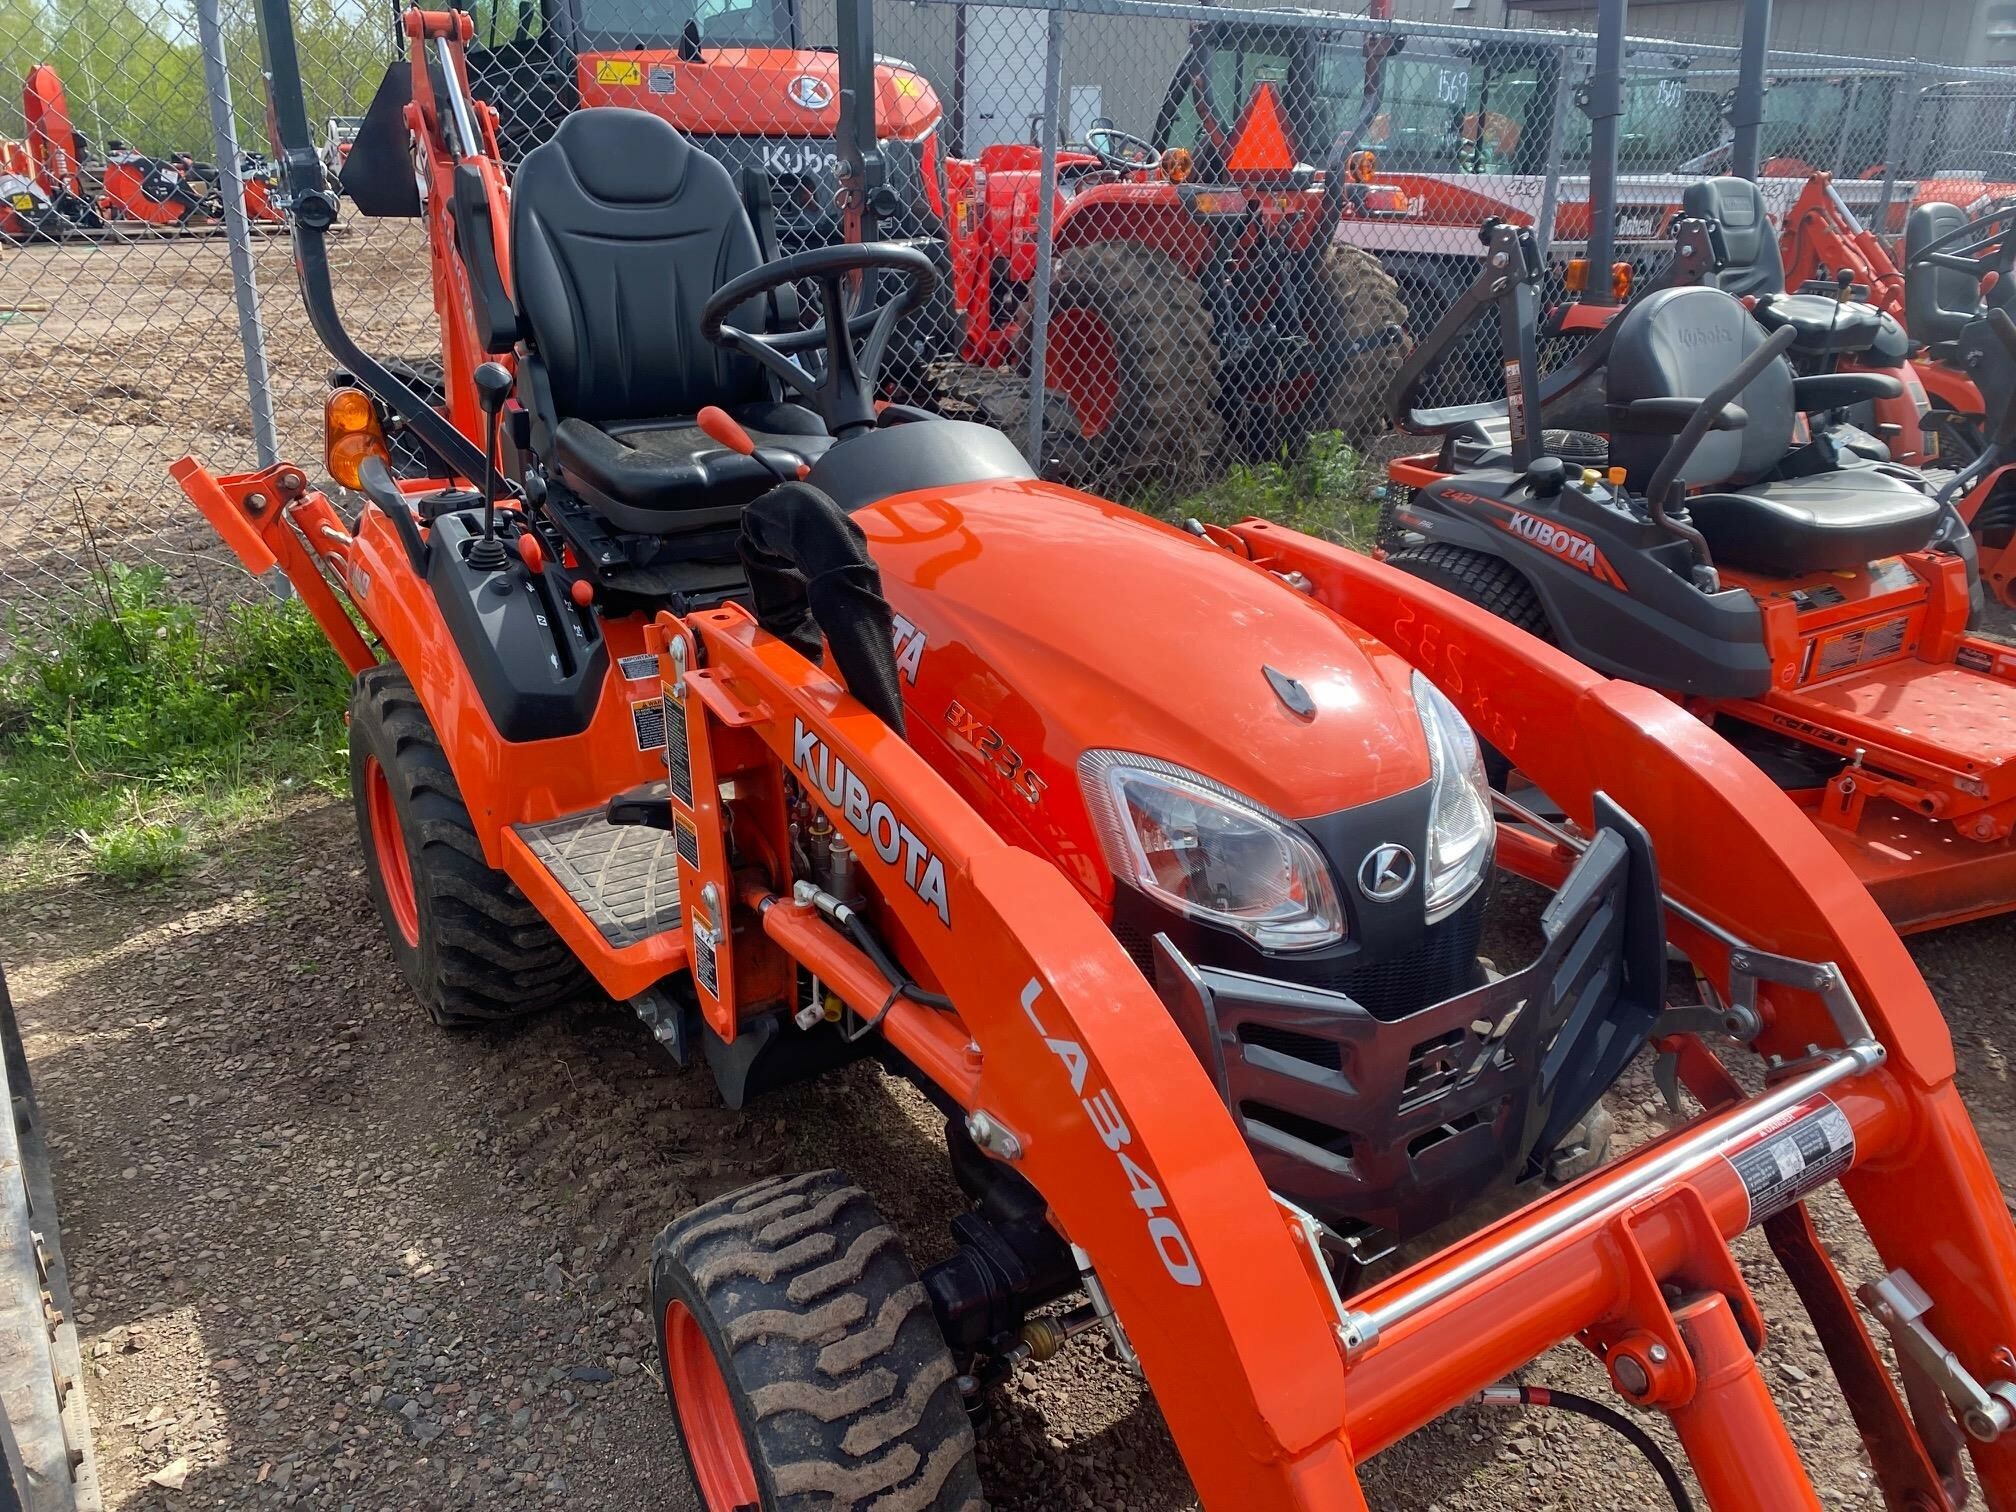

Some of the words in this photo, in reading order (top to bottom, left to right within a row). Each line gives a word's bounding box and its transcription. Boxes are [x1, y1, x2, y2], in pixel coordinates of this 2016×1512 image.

[1438, 67, 1468, 107] 1569
[763, 146, 838, 174] Kubo
[1508, 511, 1597, 568] KUBOTA
[944, 700, 1049, 804] BX23S
[792, 716, 952, 930] KUBOTA
[1020, 976, 1202, 1287] LA340
[1765, 1113, 1797, 1133] DANGER
